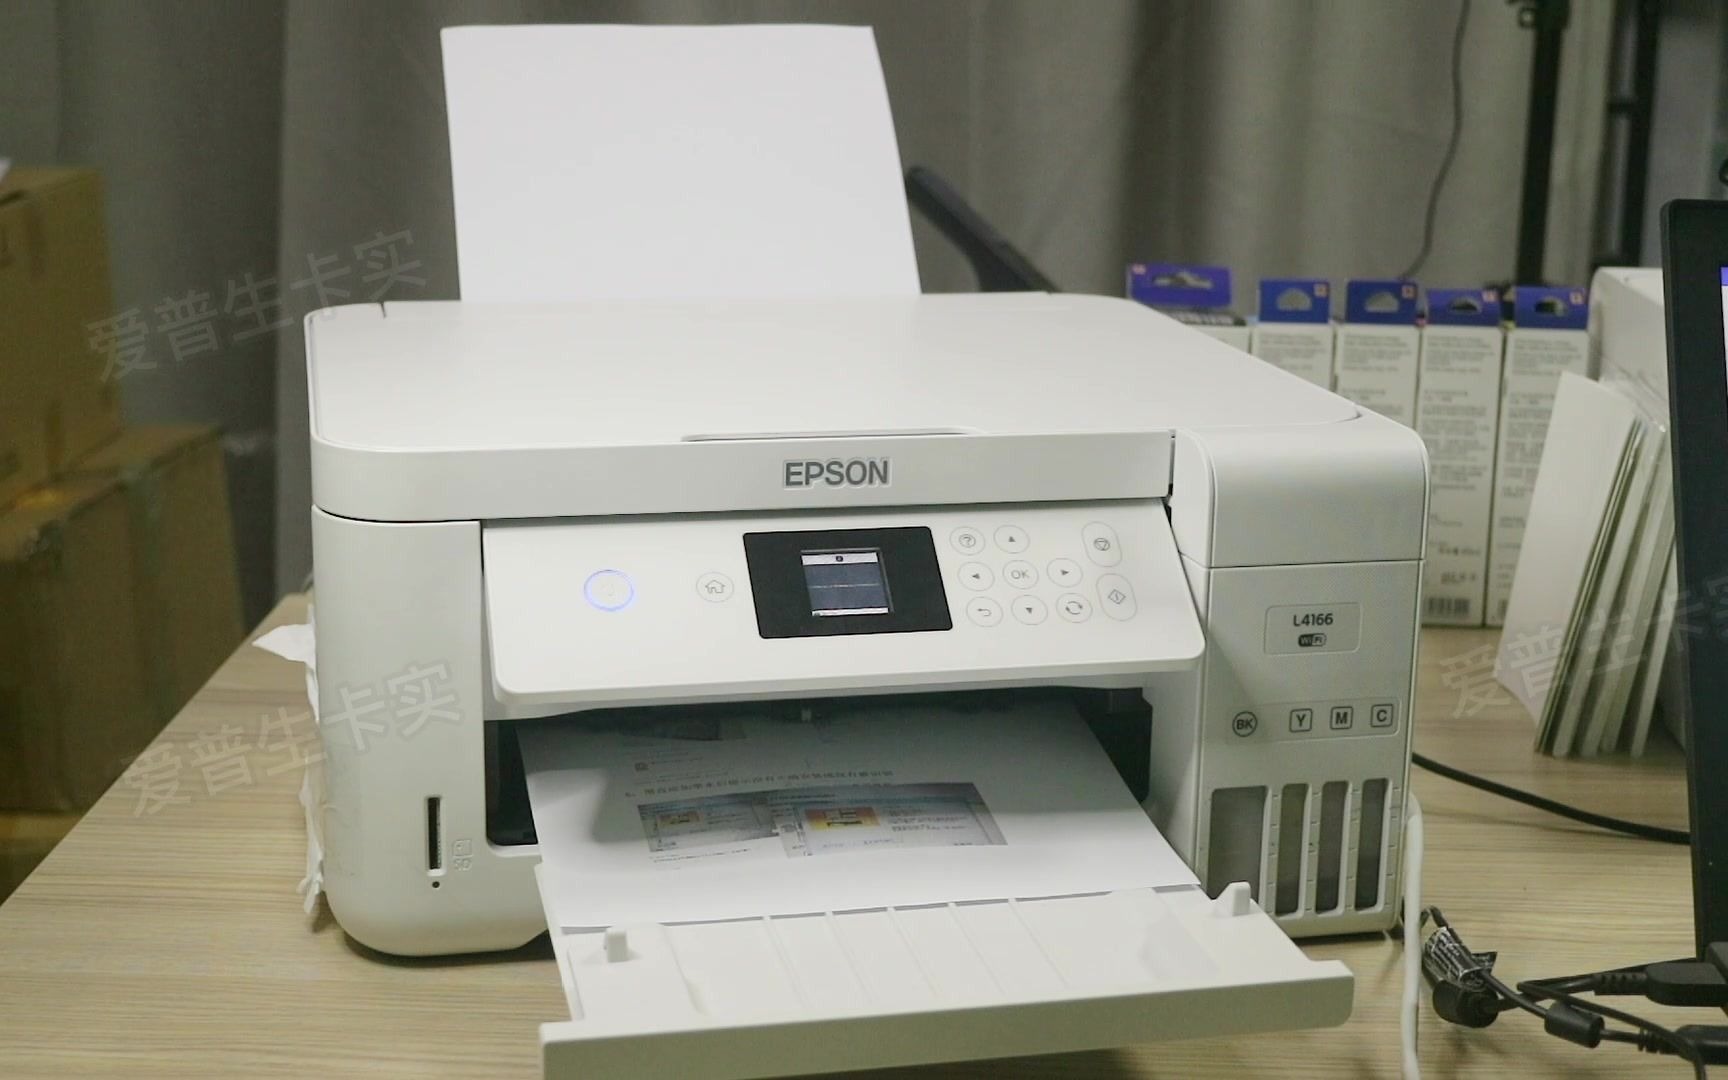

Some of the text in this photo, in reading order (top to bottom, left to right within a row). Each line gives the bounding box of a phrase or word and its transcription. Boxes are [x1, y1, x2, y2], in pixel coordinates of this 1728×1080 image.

[785, 459, 889, 488] EPSON
[1010, 569, 1030, 580] OK
[1293, 613, 1334, 627] L4166
[1236, 718, 1254, 731] BK
